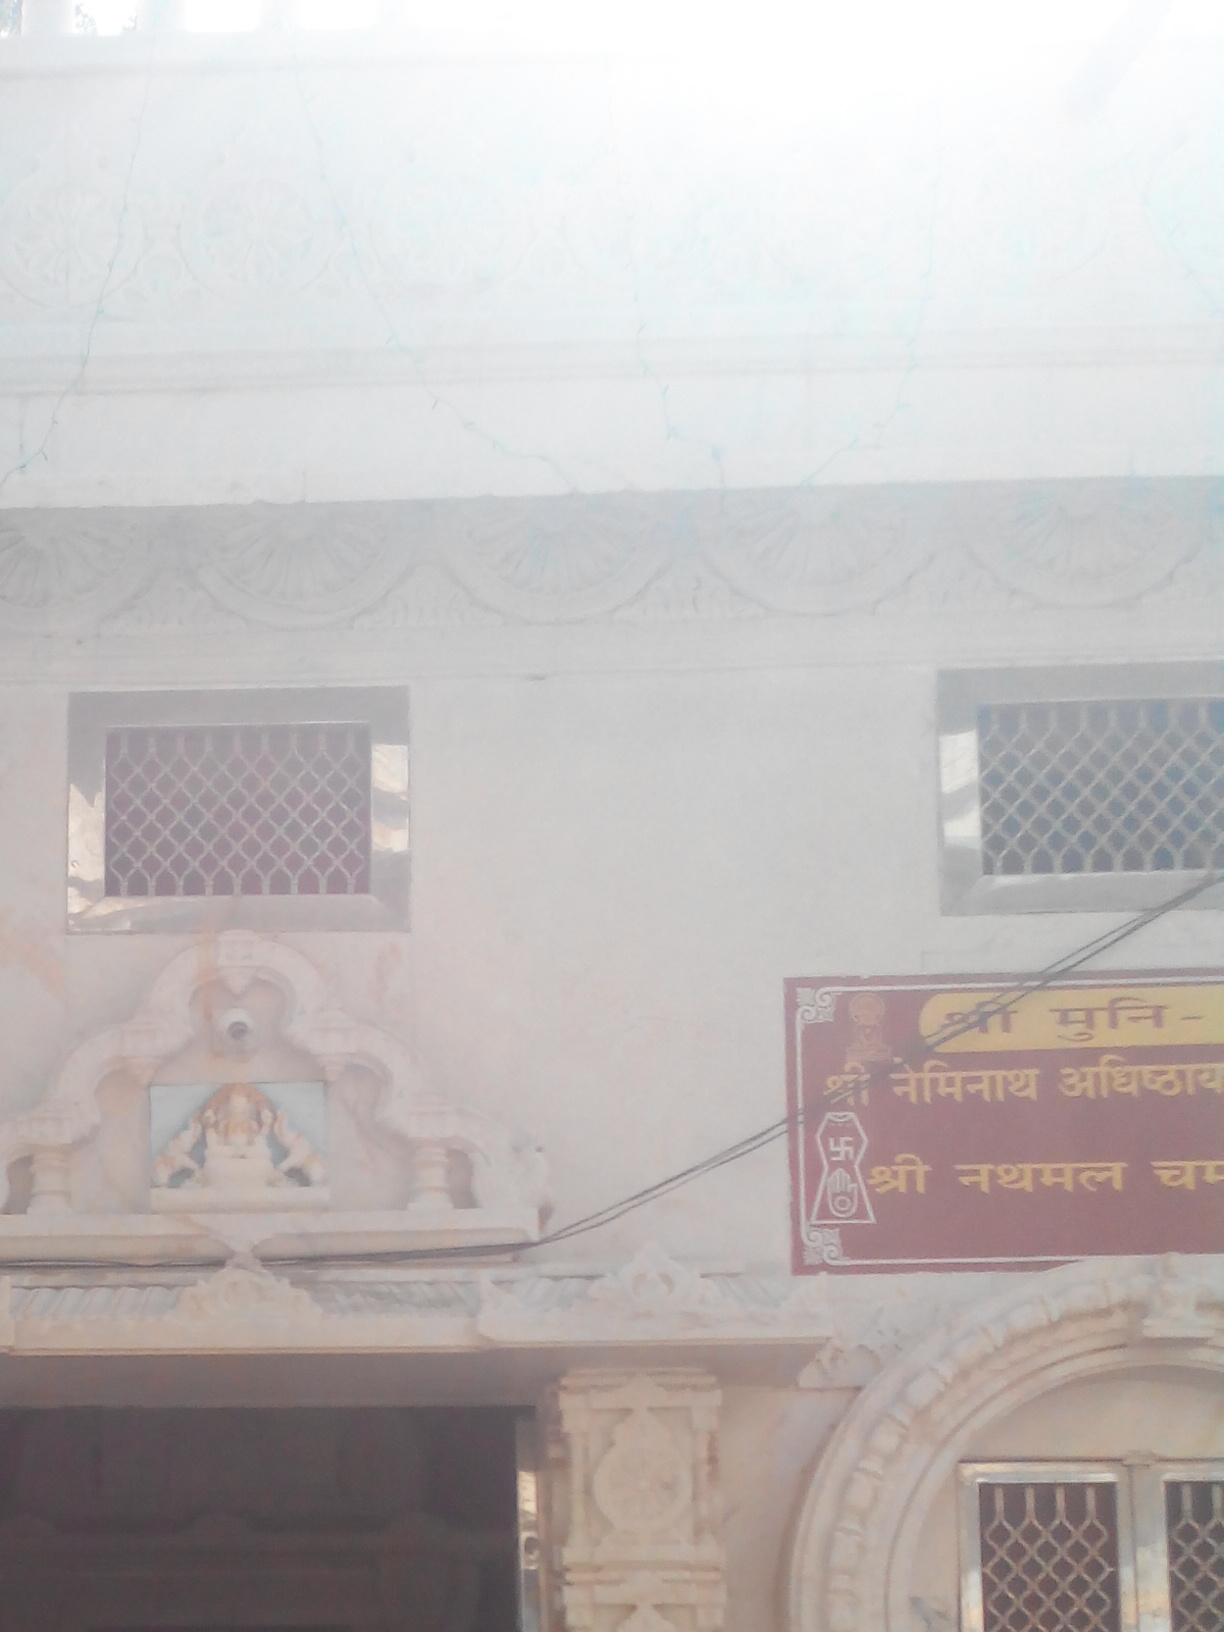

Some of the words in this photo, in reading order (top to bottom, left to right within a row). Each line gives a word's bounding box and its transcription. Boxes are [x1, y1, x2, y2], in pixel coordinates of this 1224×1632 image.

[889, 1058, 1040, 1104] नेमिनाथ
[868, 1153, 932, 1195] श्री
[954, 1162, 1128, 1193] नथमल
